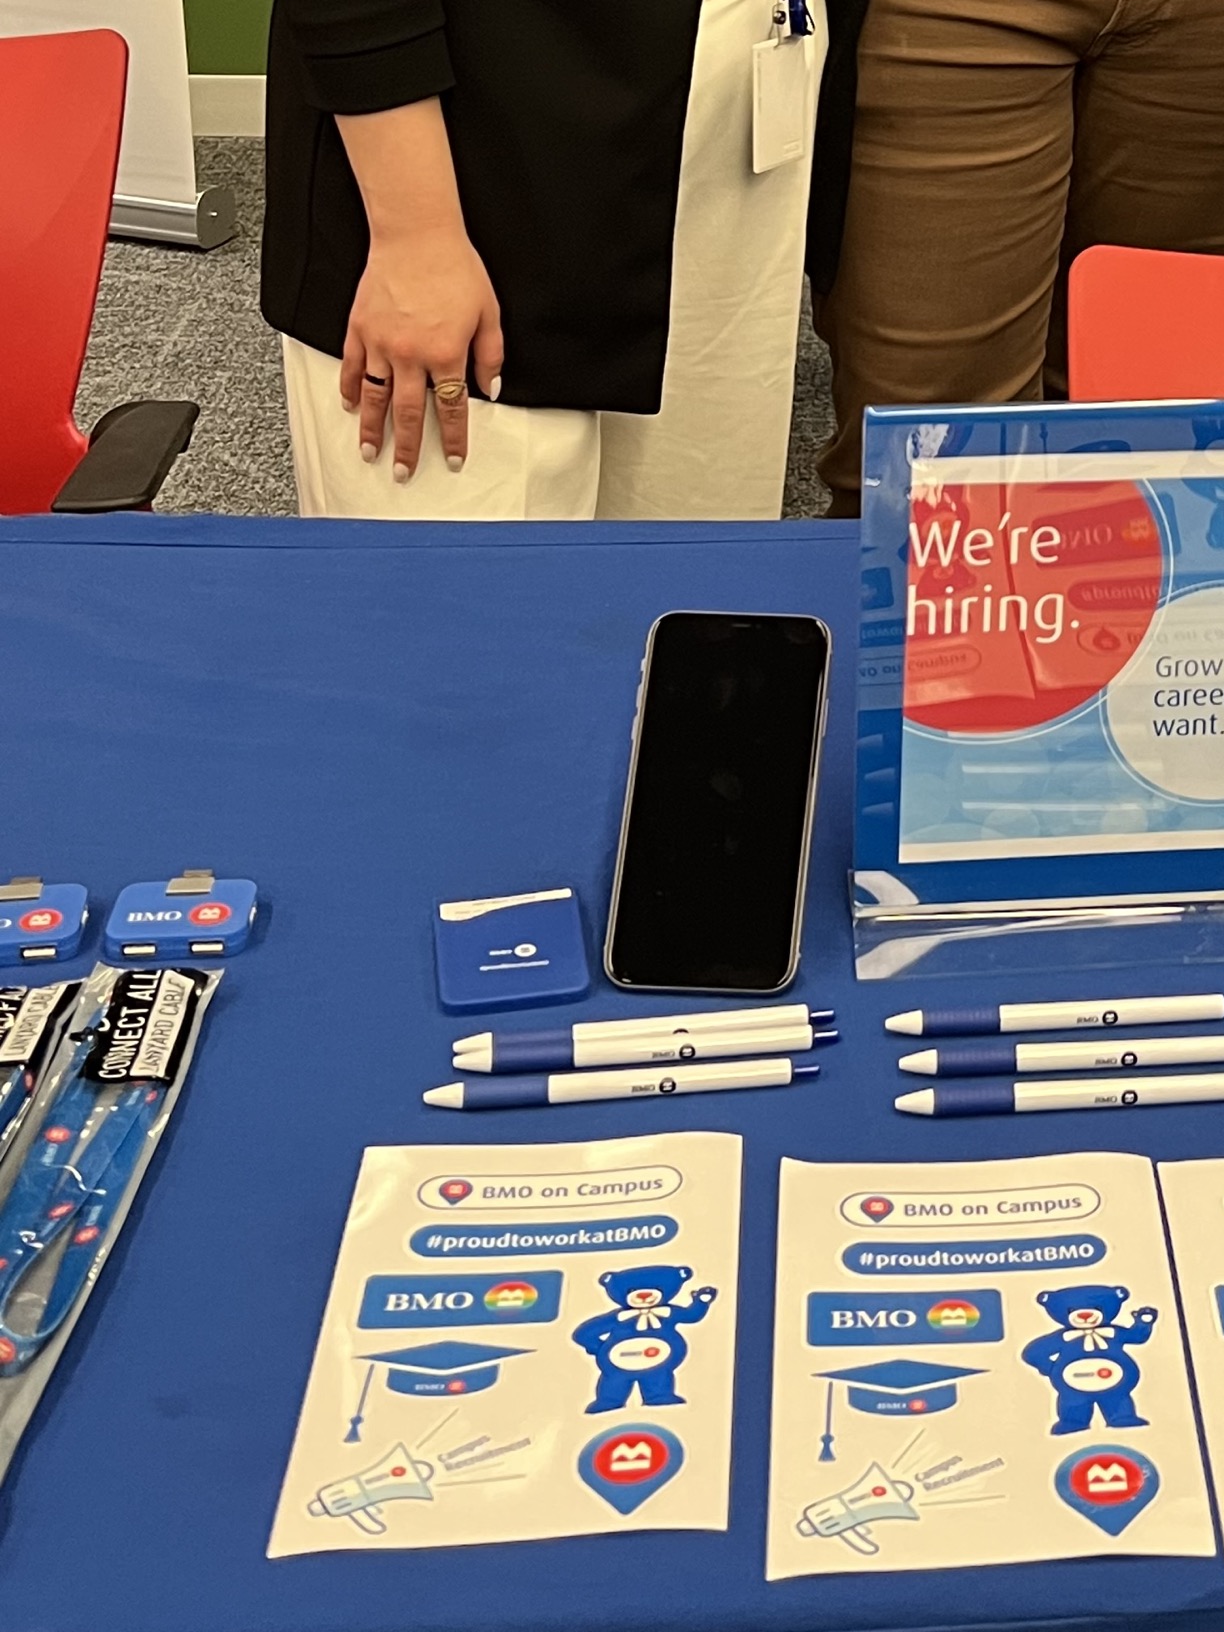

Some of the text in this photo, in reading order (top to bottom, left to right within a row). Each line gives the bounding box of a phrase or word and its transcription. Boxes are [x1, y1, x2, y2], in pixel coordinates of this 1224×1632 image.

[908, 511, 1061, 568] We're
[906, 583, 1081, 644] hiring.
[1155, 655, 1224, 679] Grow
[127, 910, 183, 923] BMO
[98, 1006, 150, 1079] CONNECT
[482, 1177, 664, 1200] BMO on Campus
[903, 1195, 1082, 1218] BMO on Campus
[426, 1224, 667, 1252] #proudtoworkatBMO
[859, 1243, 1095, 1270] #proudtoworkatBMO
[383, 1291, 475, 1312] BMO
[830, 1309, 918, 1329] BMO
